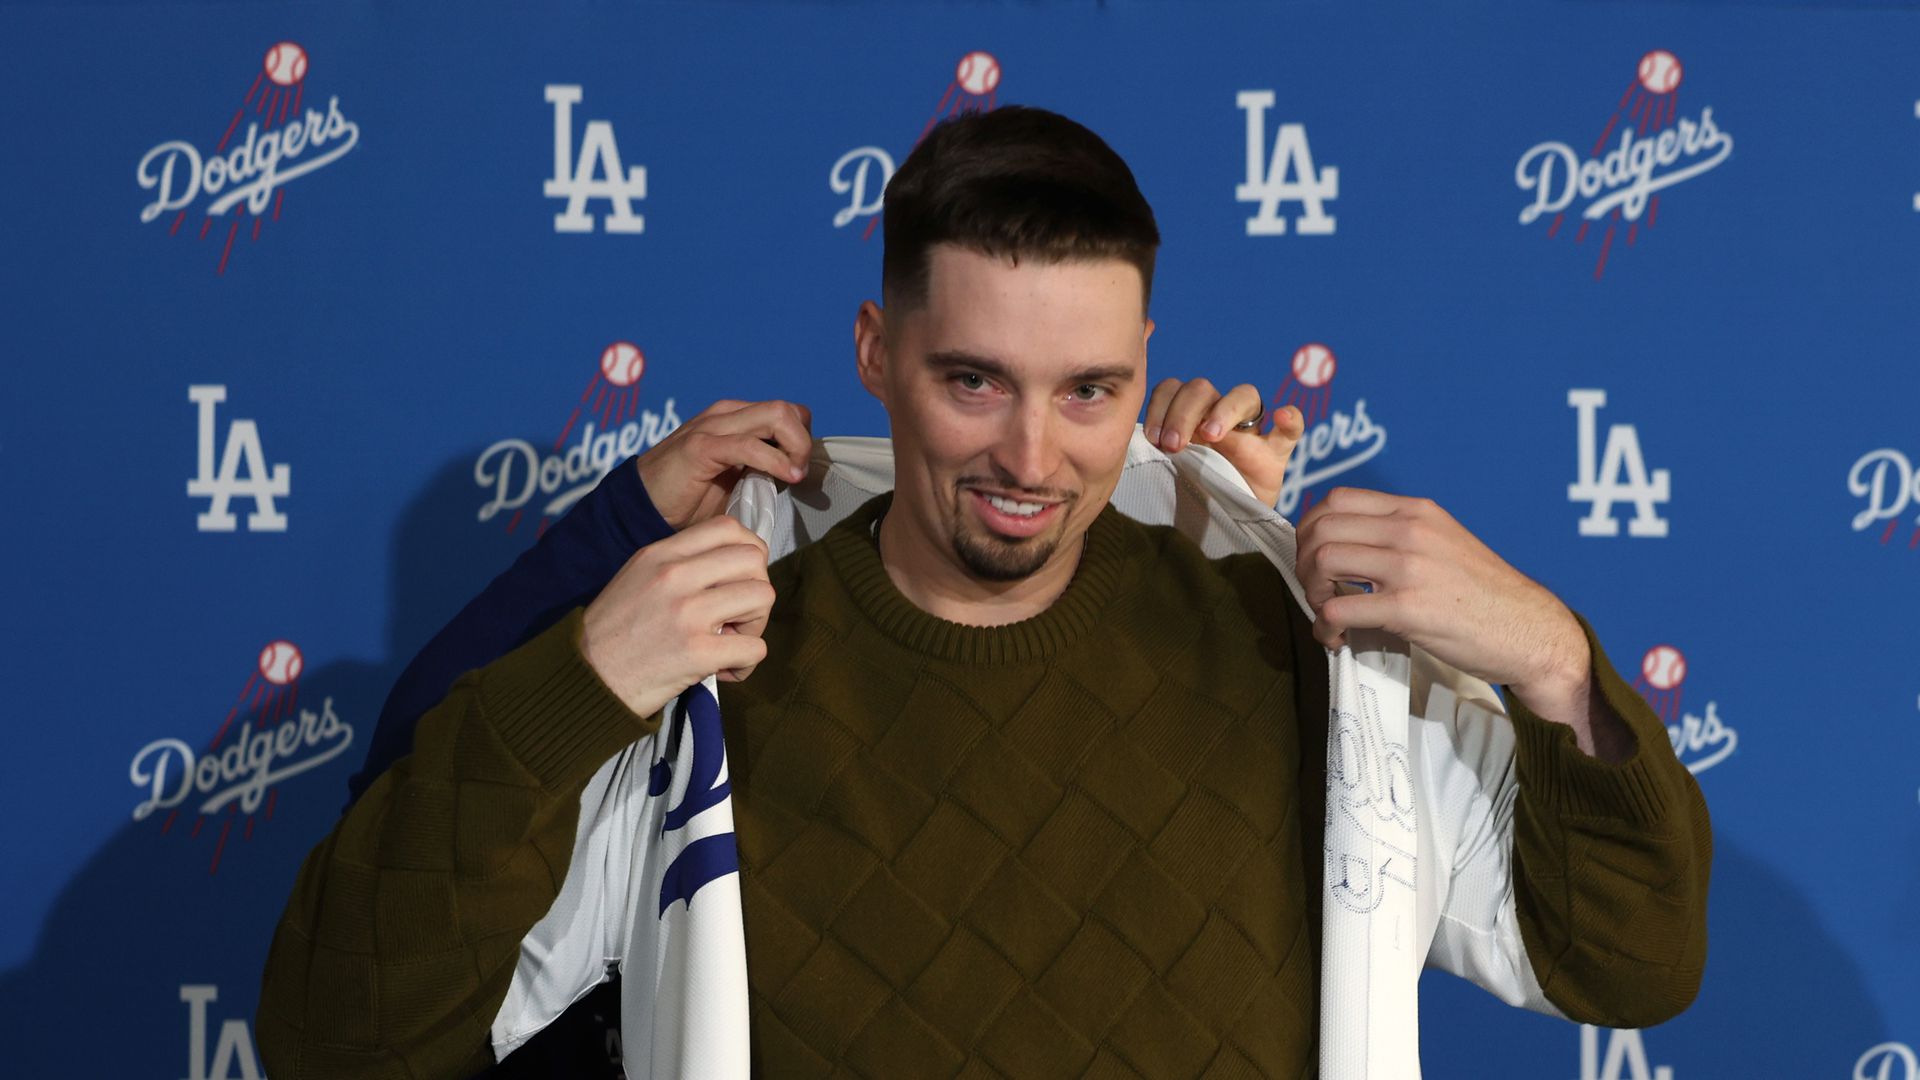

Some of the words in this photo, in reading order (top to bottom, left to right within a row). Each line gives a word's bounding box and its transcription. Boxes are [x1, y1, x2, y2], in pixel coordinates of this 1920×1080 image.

[137, 97, 359, 222] Dodgers
[544, 85, 646, 233] LA
[1236, 91, 1338, 235] LA
[1516, 108, 1733, 224] Dodgers
[187, 385, 290, 531] LA
[1277, 399, 1386, 516] gers
[1568, 389, 1670, 537] LA
[130, 698, 353, 821] Dodgers
